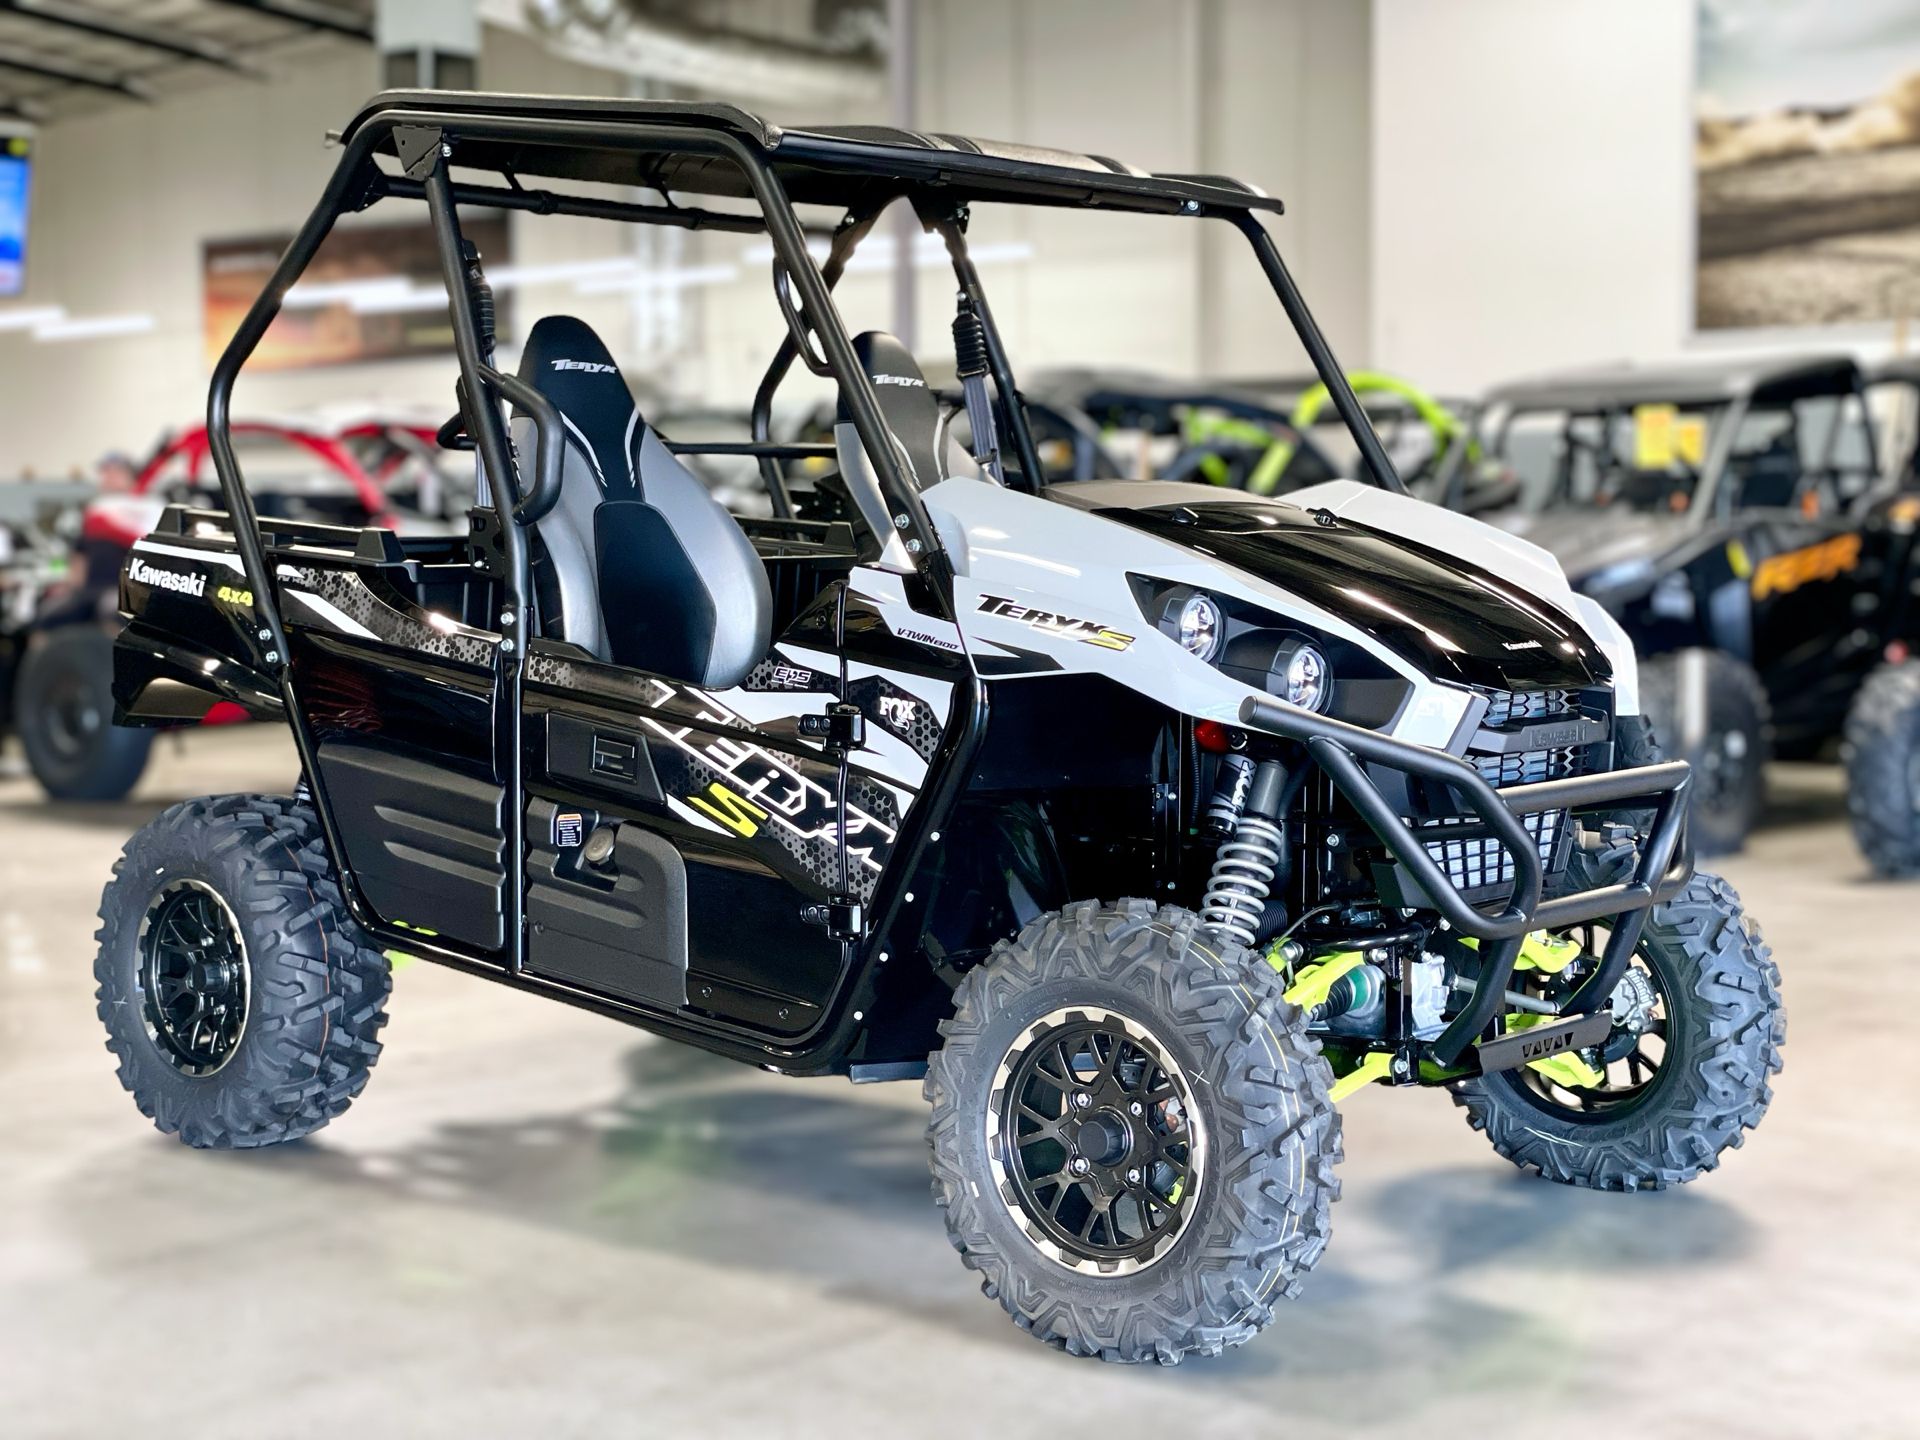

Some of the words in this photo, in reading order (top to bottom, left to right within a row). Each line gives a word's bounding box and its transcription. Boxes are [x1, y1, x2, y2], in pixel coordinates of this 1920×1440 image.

[129, 558, 207, 597] Kawasaki
[217, 586, 254, 607] 4x4
[897, 627, 936, 644] V-TWIN
[879, 696, 917, 730] FOX
